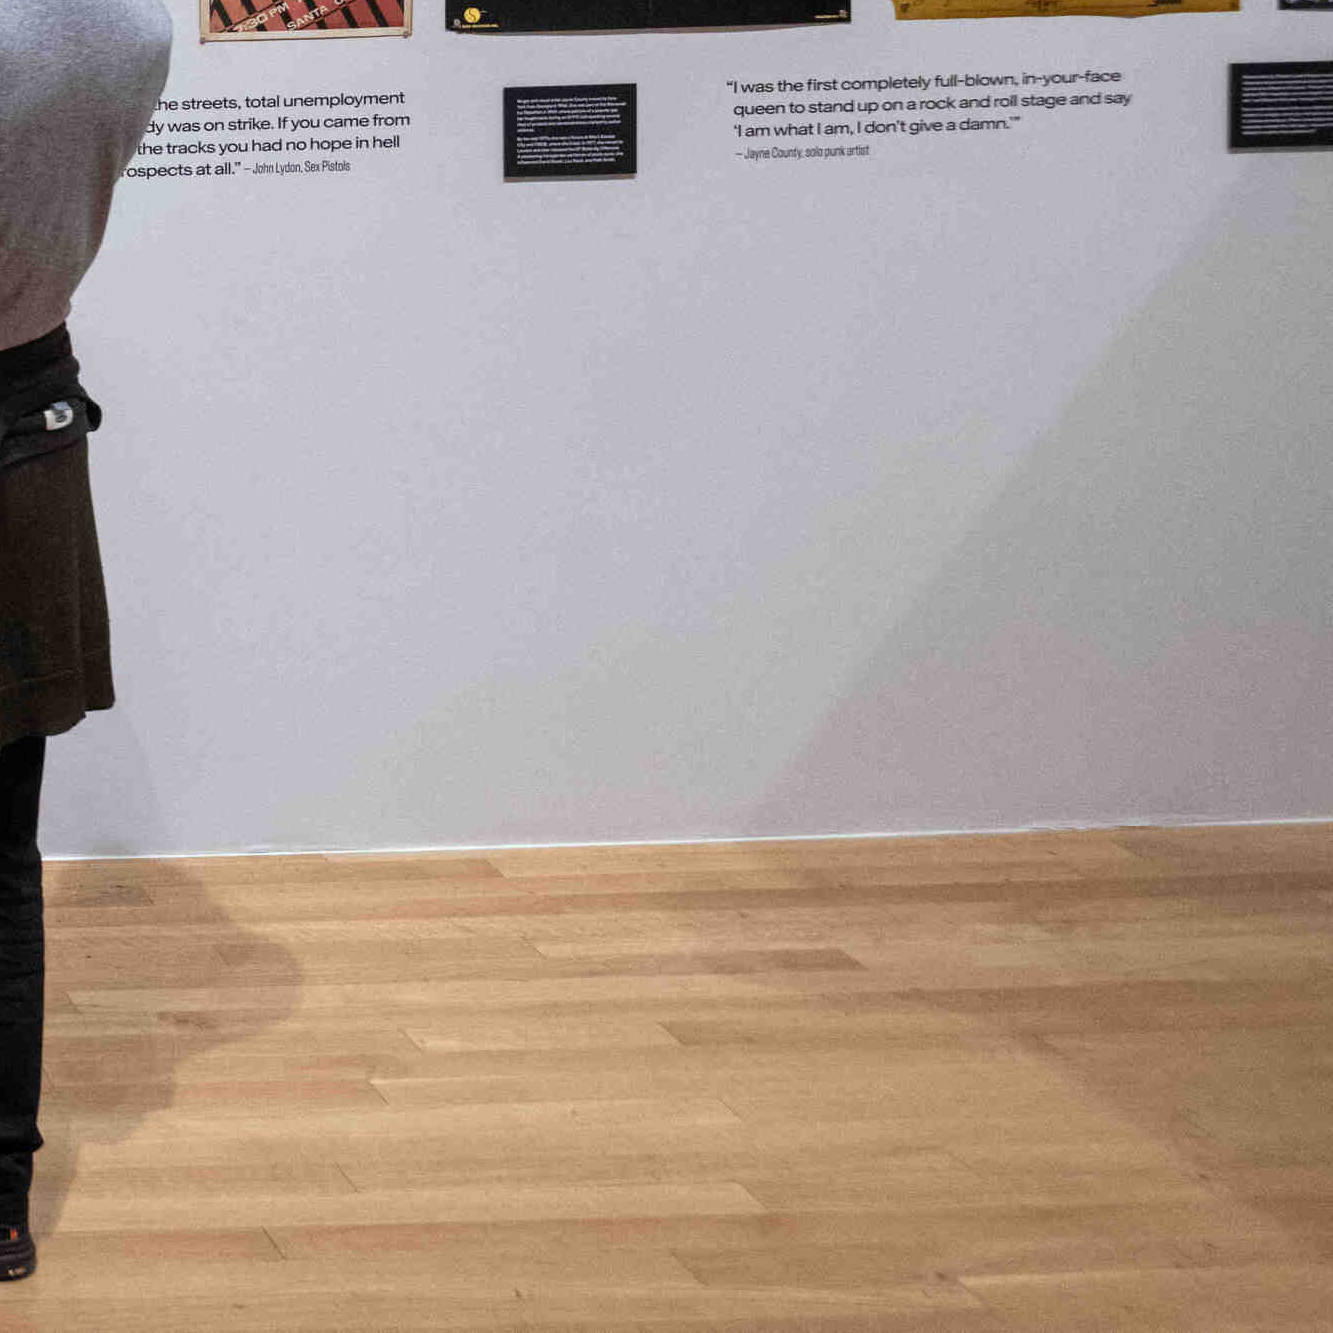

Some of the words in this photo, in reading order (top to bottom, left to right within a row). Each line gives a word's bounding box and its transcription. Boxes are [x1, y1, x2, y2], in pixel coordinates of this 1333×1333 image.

[287, 4, 329, 31] SANTA
[740, 81, 775, 95] was
[776, 78, 805, 94] the
[806, 77, 839, 92] first
[840, 74, 932, 93] completely
[933, 73, 1020, 89] full-blown,
[1021, 68, 1122, 89] in-your-face
[166, 121, 202, 133] was
[203, 120, 225, 133] on
[227, 116, 275, 132] strike.
[277, 115, 289, 130] If
[290, 117, 321, 134] you
[323, 116, 370, 129] came
[372, 113, 411, 128] from
